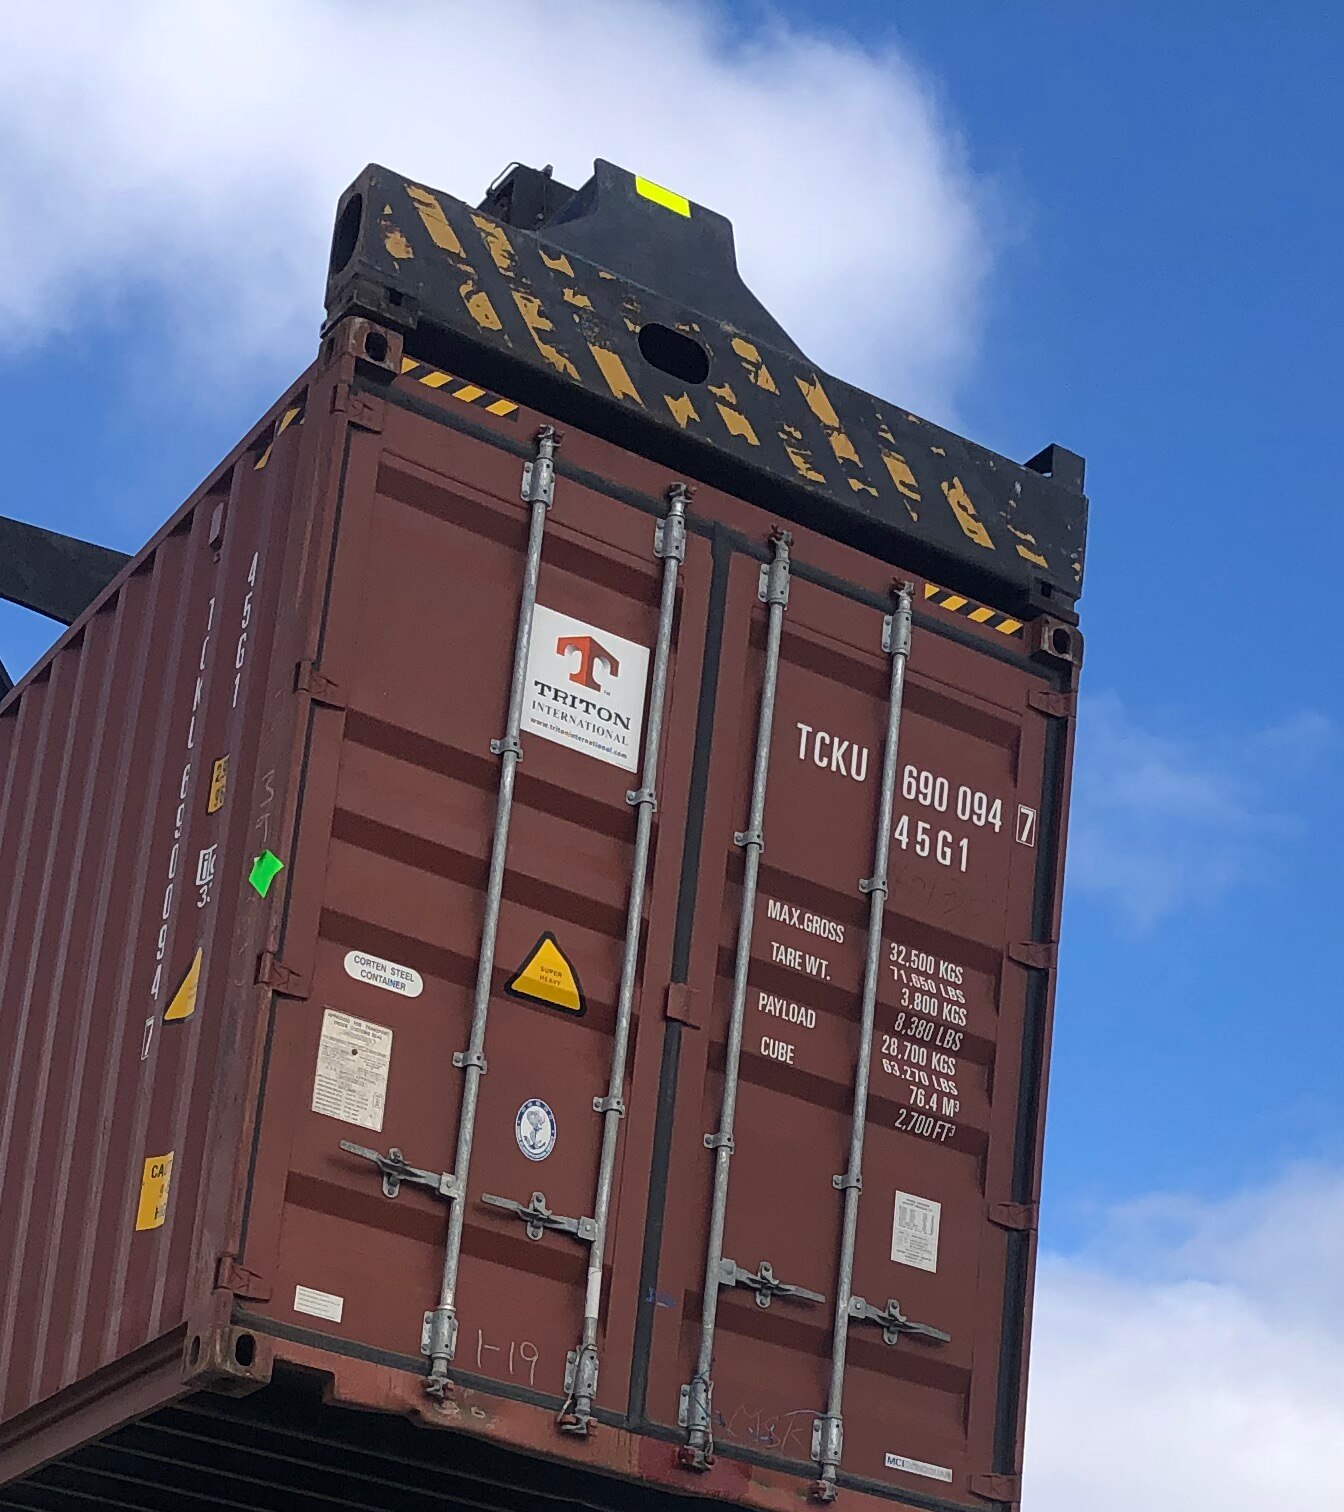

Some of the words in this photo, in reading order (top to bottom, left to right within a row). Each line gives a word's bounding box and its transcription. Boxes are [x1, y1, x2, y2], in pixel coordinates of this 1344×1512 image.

[532, 700, 629, 746] INTERNATIONAL
[534, 680, 631, 731] TRITON
[796, 722, 868, 782] TCKU
[902, 764, 949, 812] 690
[957, 786, 1002, 833] 094
[1018, 805, 1035, 845] 7
[894, 815, 969, 872] 45G1
[767, 899, 845, 944] MAX.GROSS
[354, 955, 387, 973] CORTEN
[390, 967, 414, 982] STEEL
[360, 969, 406, 991] CONTAINER
[771, 941, 802, 971] TARE
[805, 955, 831, 981] WT.
[889, 942, 935, 975] 32,500
[939, 960, 963, 985] KGS
[758, 992, 816, 1029] PAYLOAD
[900, 988, 938, 1016] 3,800
[942, 1001, 967, 1027] KGS
[940, 984, 965, 1004] LBS
[760, 1036, 795, 1065] CUBE
[894, 1012, 935, 1042] 8,380
[936, 1026, 964, 1052] LBS
[881, 1035, 927, 1066] 28,700
[931, 1051, 956, 1076] KGS
[909, 1085, 937, 1112] 76.4
[932, 1075, 958, 1095] LBS
[894, 1108, 934, 1137] 2,700
